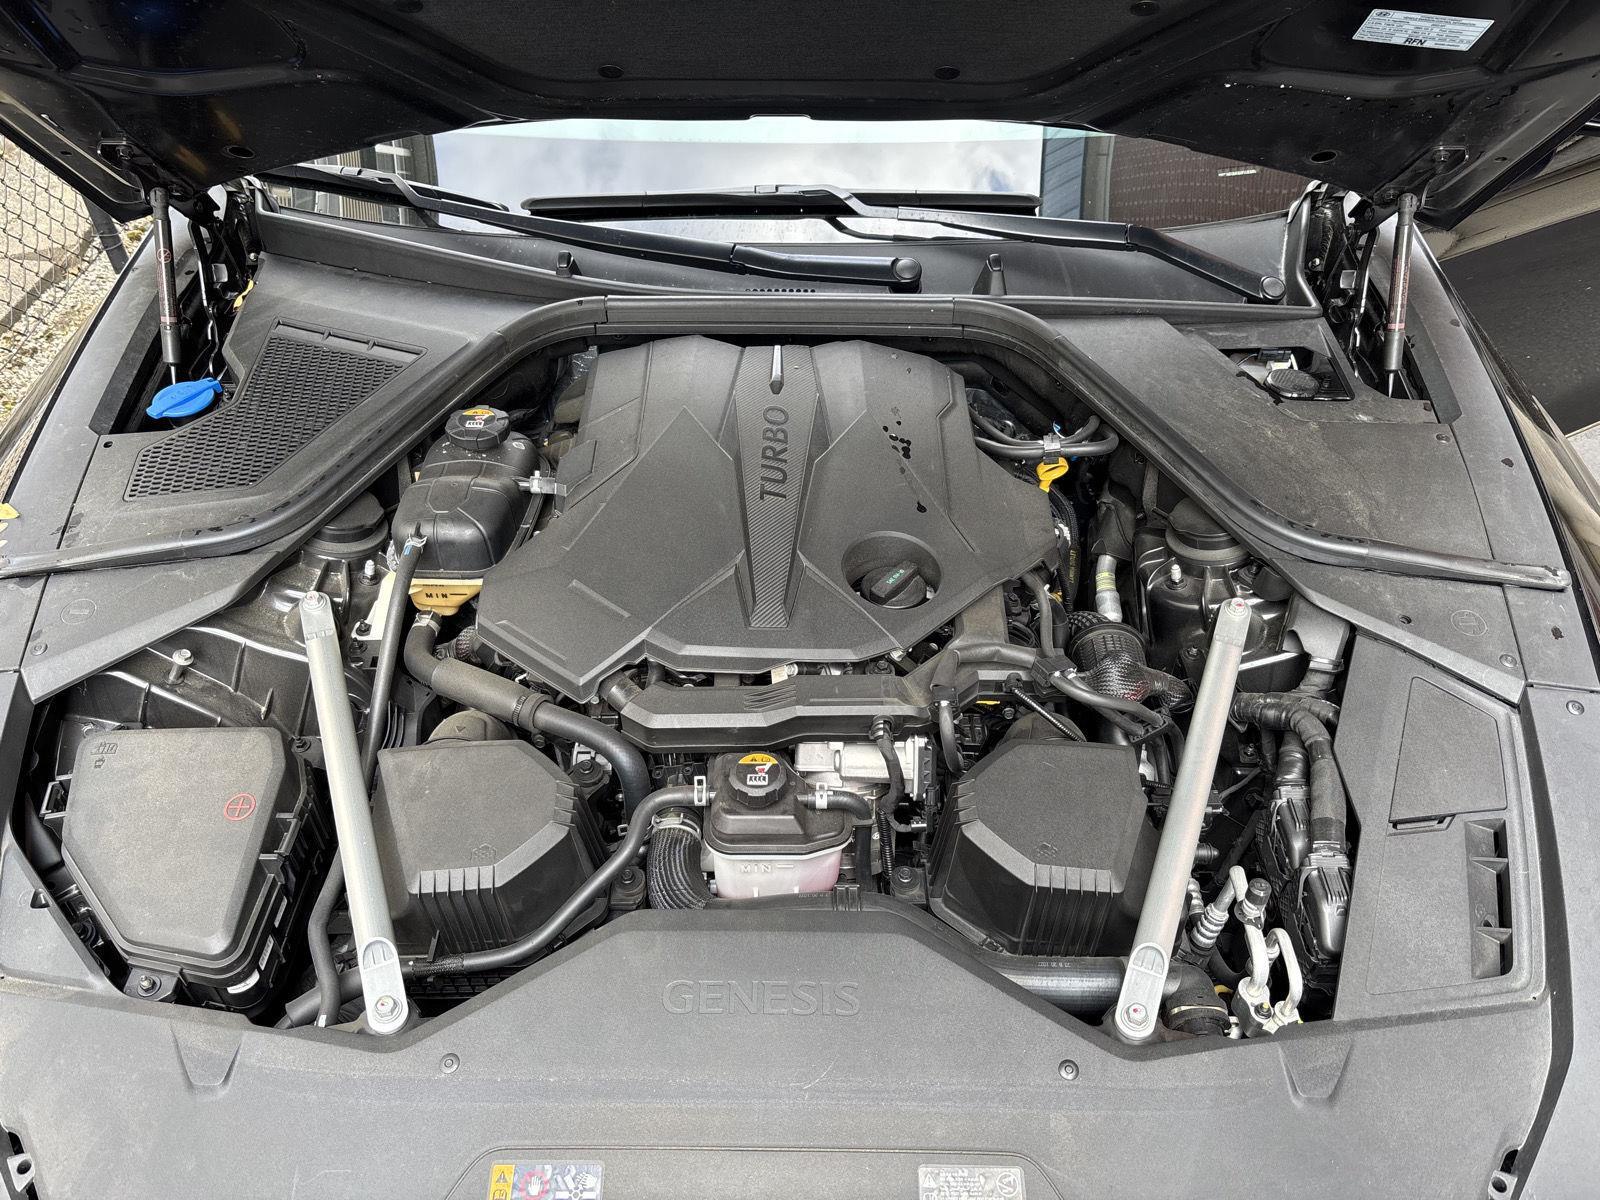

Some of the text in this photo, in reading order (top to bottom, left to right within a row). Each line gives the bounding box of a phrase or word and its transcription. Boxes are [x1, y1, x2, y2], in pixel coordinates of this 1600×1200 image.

[1403, 38, 1428, 46] RFN
[760, 405, 789, 500] TURBO
[740, 863, 772, 874] MIN
[661, 979, 861, 1017] GENESIS
